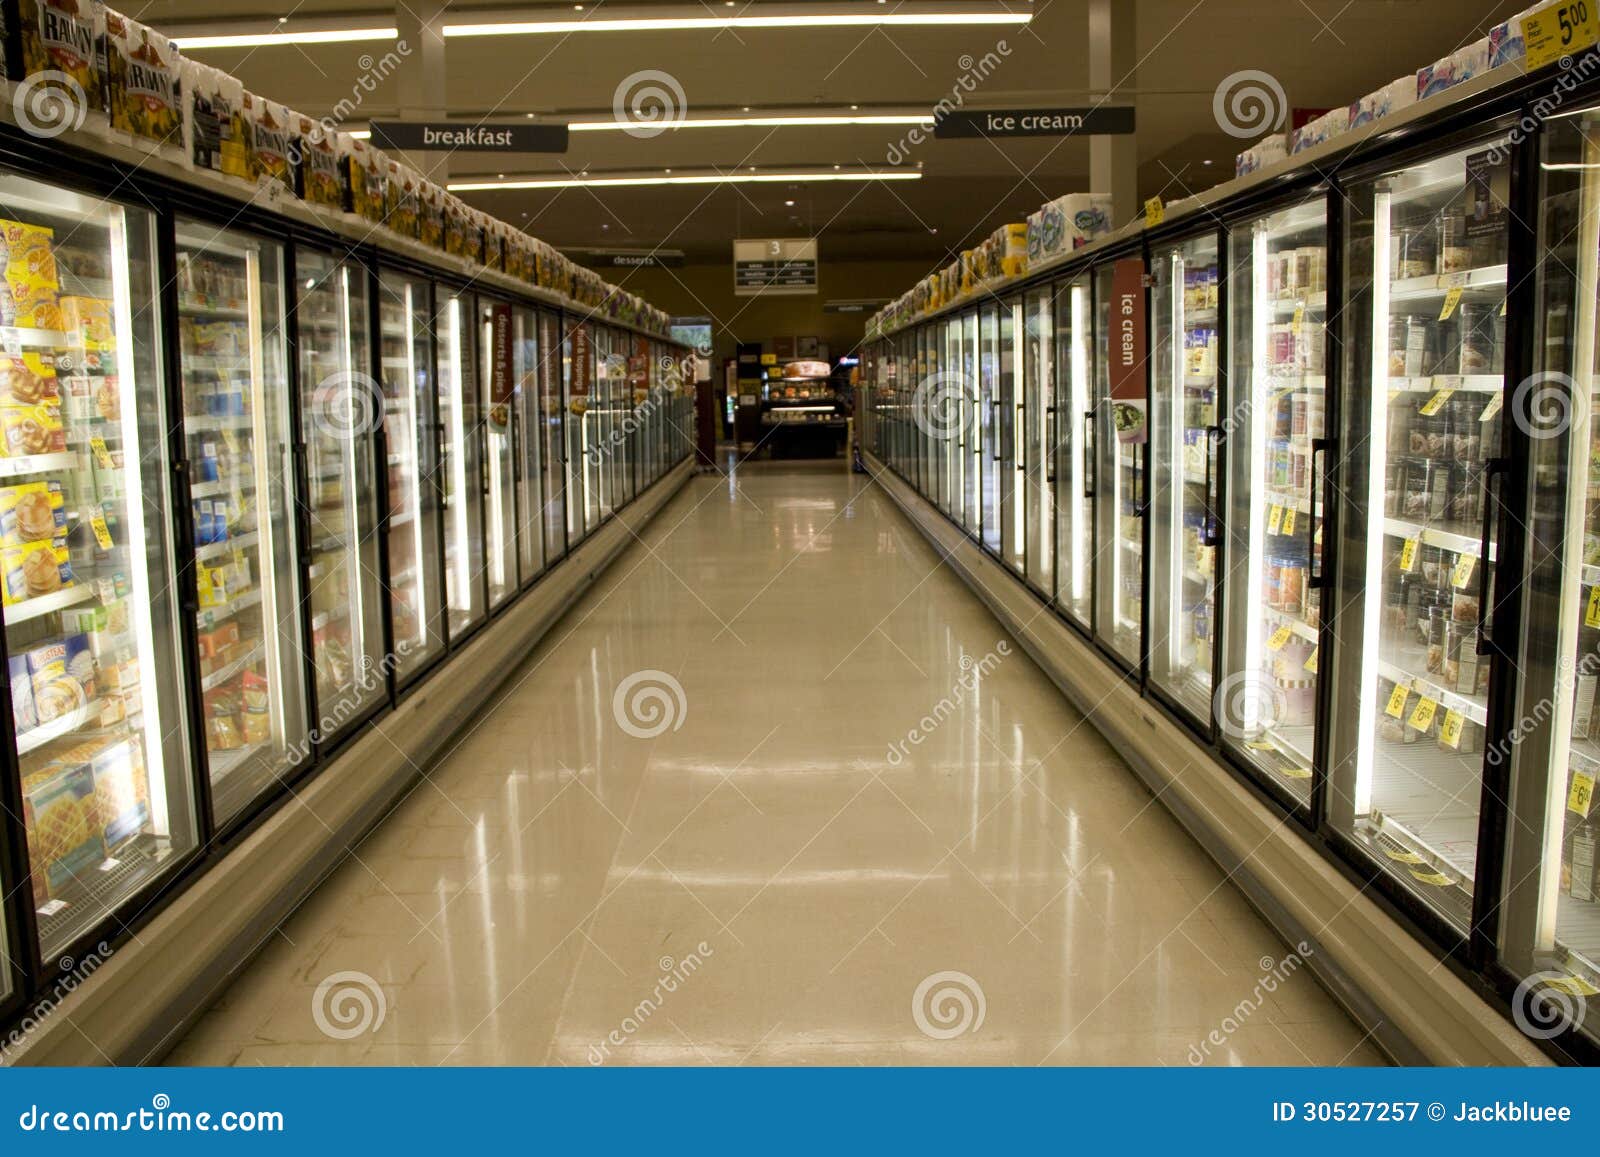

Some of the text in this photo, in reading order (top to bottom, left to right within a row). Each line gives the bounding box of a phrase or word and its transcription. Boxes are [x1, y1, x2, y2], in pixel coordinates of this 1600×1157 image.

[987, 114, 1083, 129] ice cream
[423, 127, 513, 146] breakfast
[771, 241, 781, 255] 3
[1121, 294, 1136, 366] ice cream
